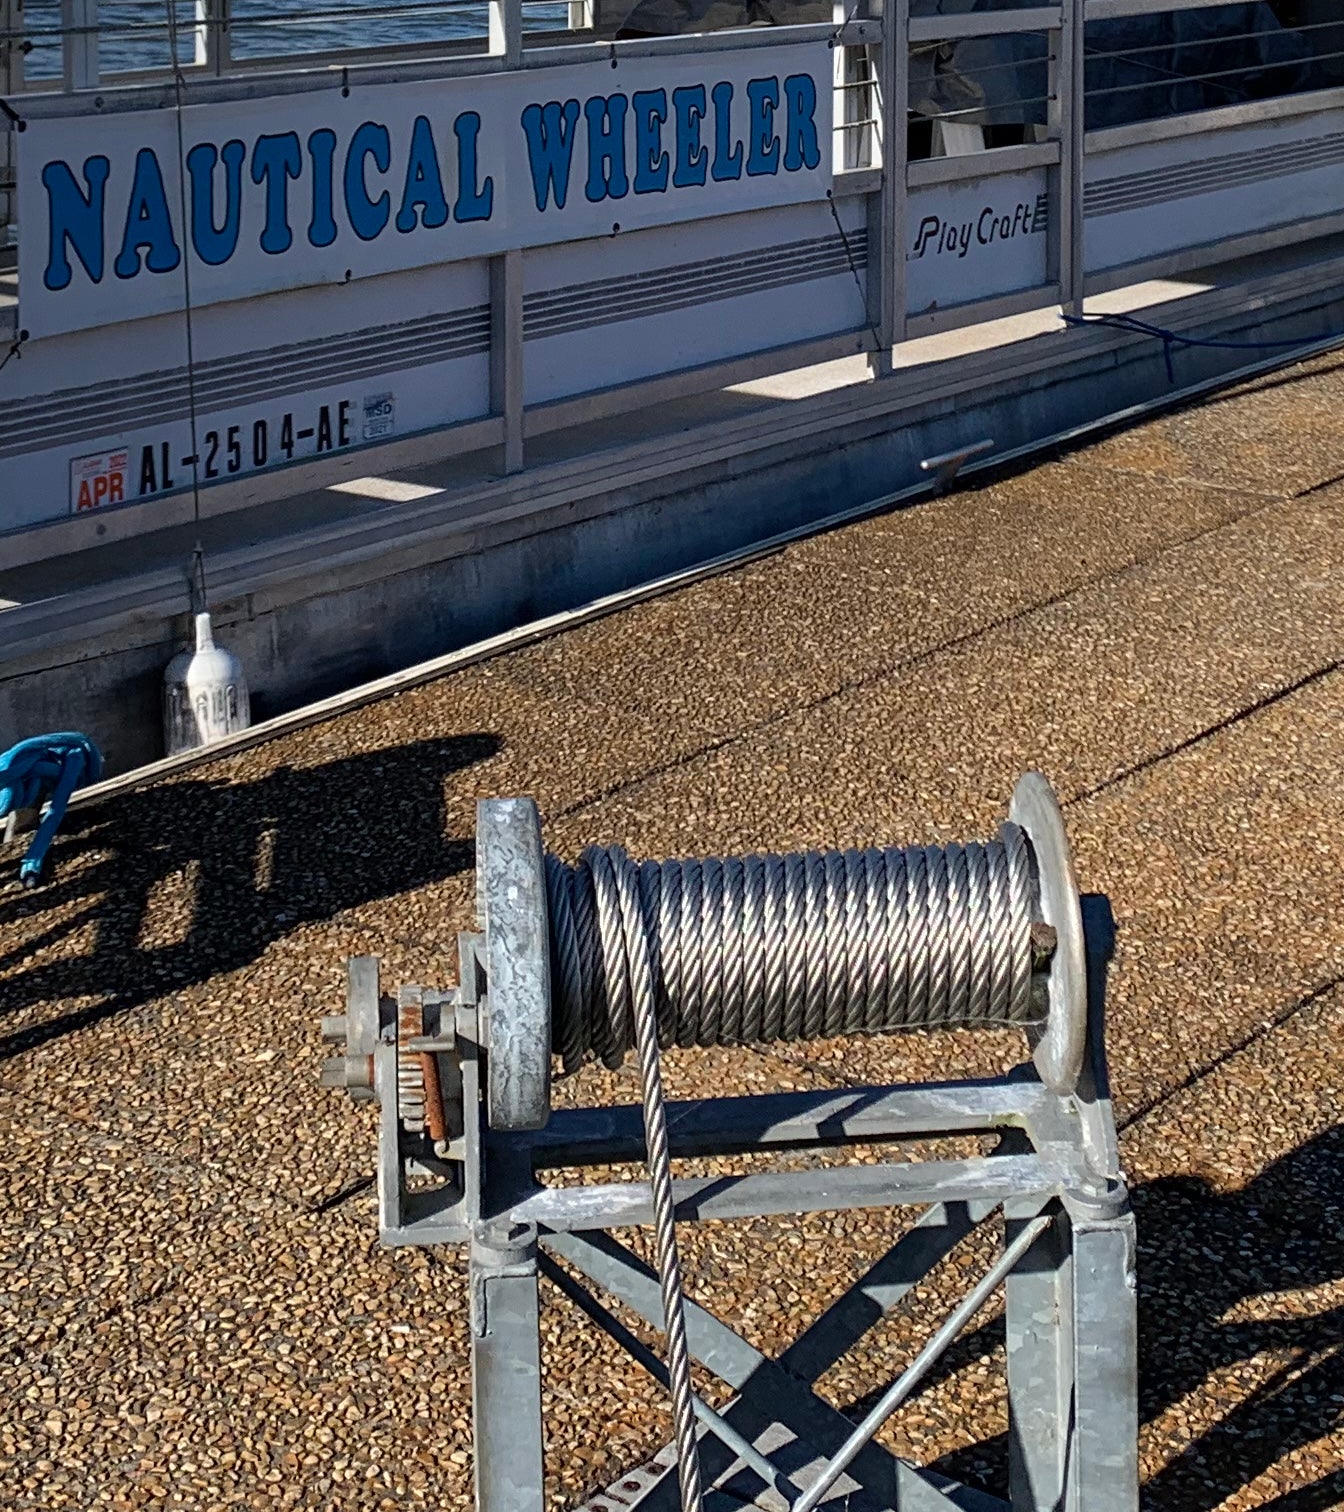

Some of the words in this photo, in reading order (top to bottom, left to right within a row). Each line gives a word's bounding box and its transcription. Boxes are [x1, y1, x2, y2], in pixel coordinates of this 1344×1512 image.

[42, 110, 494, 291] NAUTICAL
[520, 72, 821, 214] WHEELER
[76, 471, 125, 512] APR
